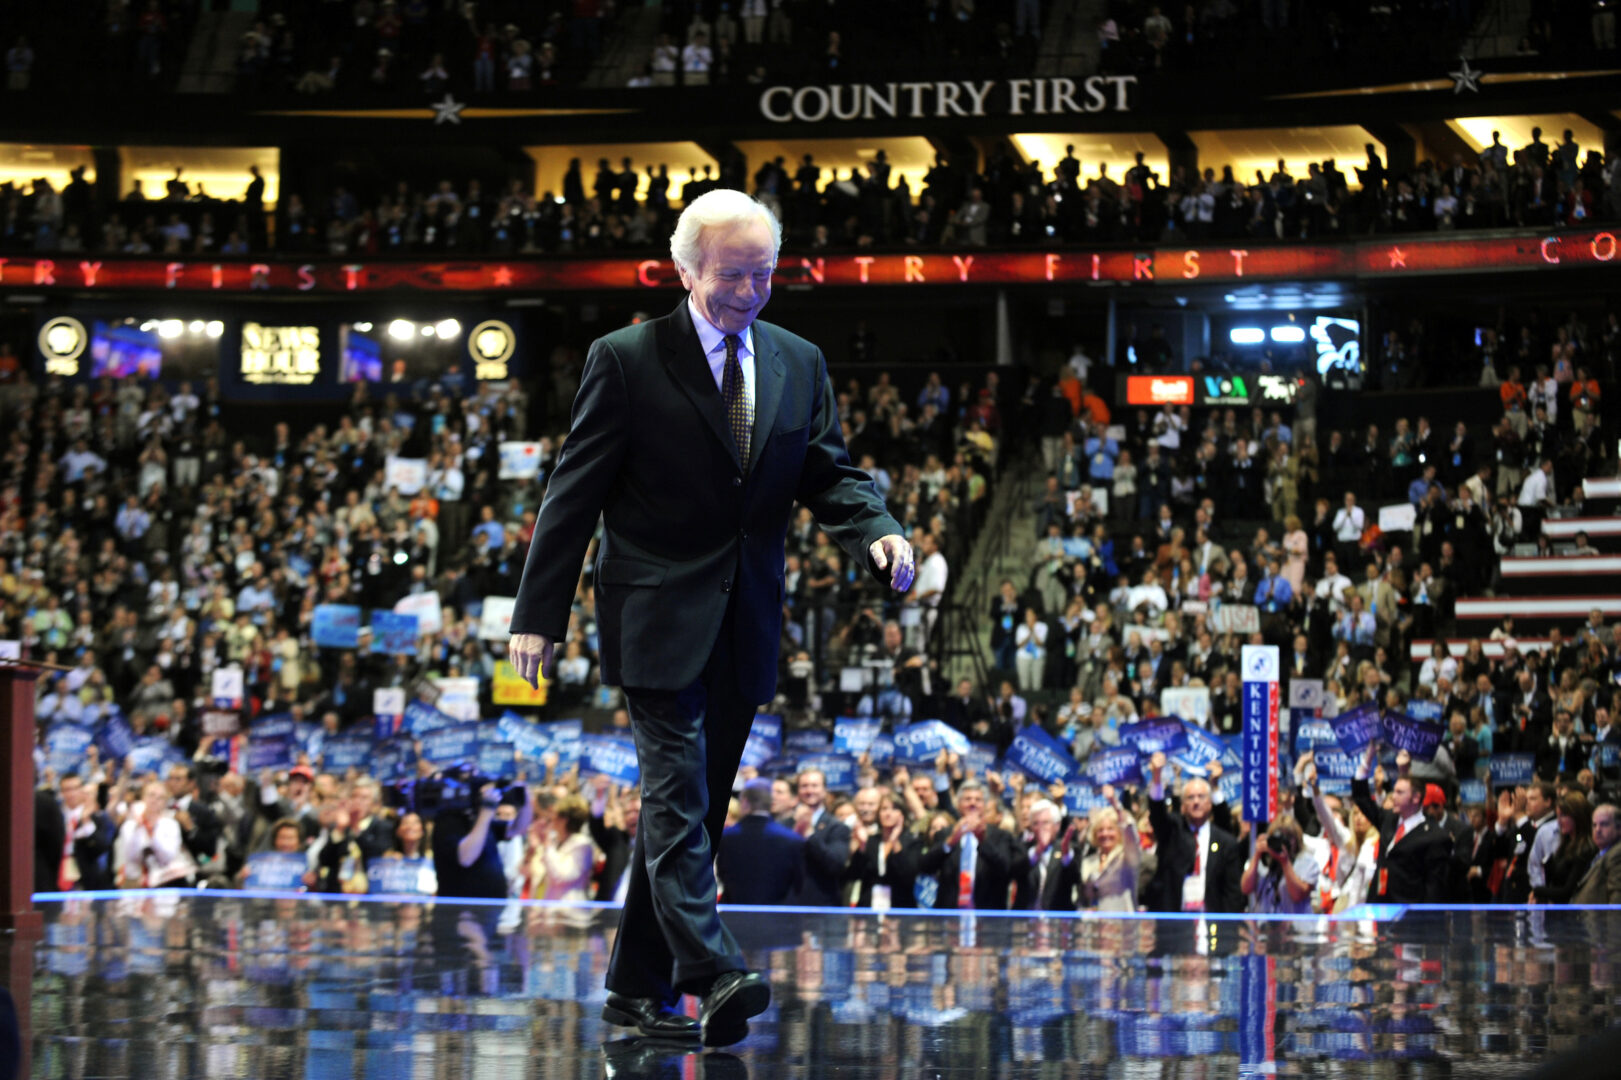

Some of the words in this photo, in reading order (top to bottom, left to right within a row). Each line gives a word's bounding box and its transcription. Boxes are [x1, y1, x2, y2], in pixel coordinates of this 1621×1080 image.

[760, 80, 995, 122] COUNTRY
[1008, 75, 1138, 115] FIRST
[166, 262, 364, 290] FIRST
[1249, 683, 1262, 819] KENTUCKY
[1383, 715, 1440, 743] COUNTRY
[1012, 734, 1071, 778] COUNTRY
